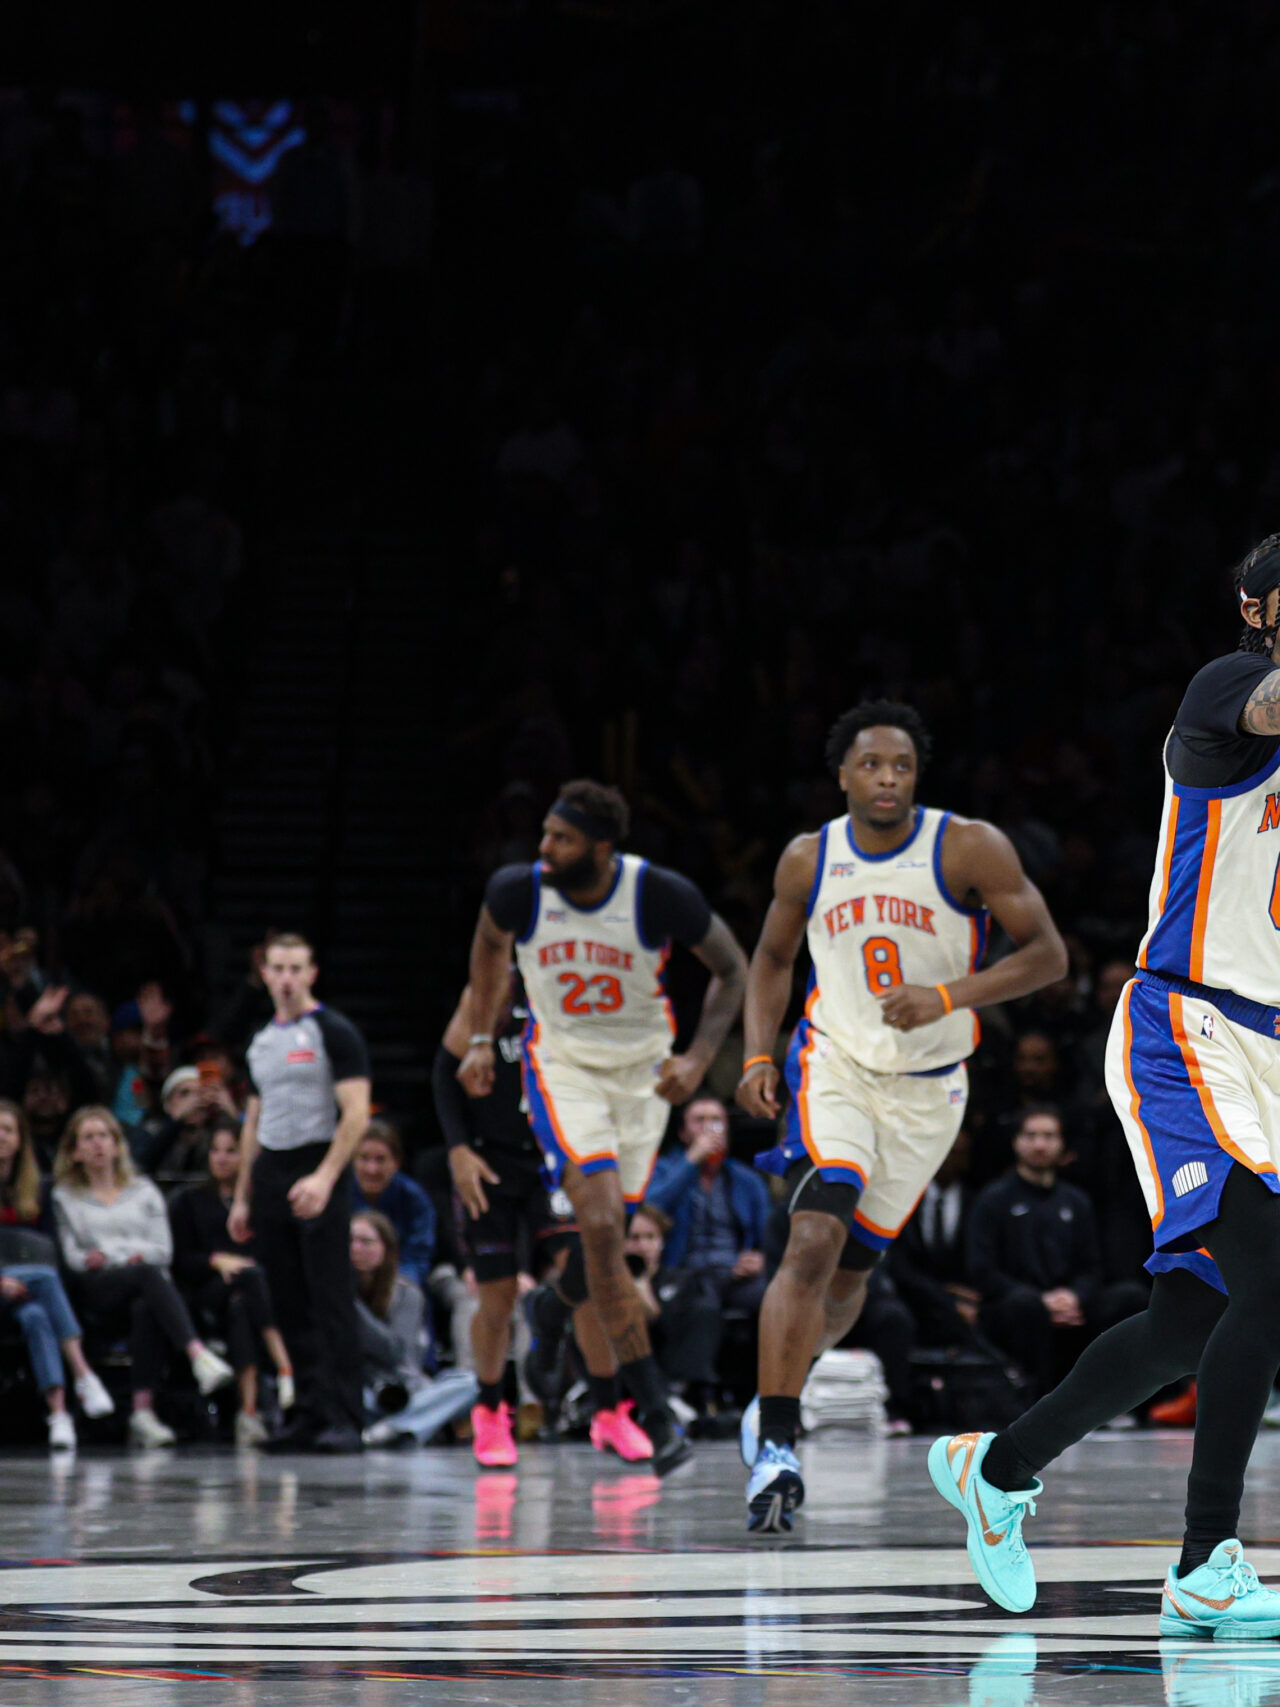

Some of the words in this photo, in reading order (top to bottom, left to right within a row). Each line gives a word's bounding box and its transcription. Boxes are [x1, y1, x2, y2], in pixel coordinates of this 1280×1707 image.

[823, 896, 866, 940] NEW
[873, 895, 937, 937] YORK
[538, 939, 577, 968] NEW
[583, 941, 635, 972] YORK
[862, 936, 903, 997] 8
[557, 972, 624, 1016] 23
